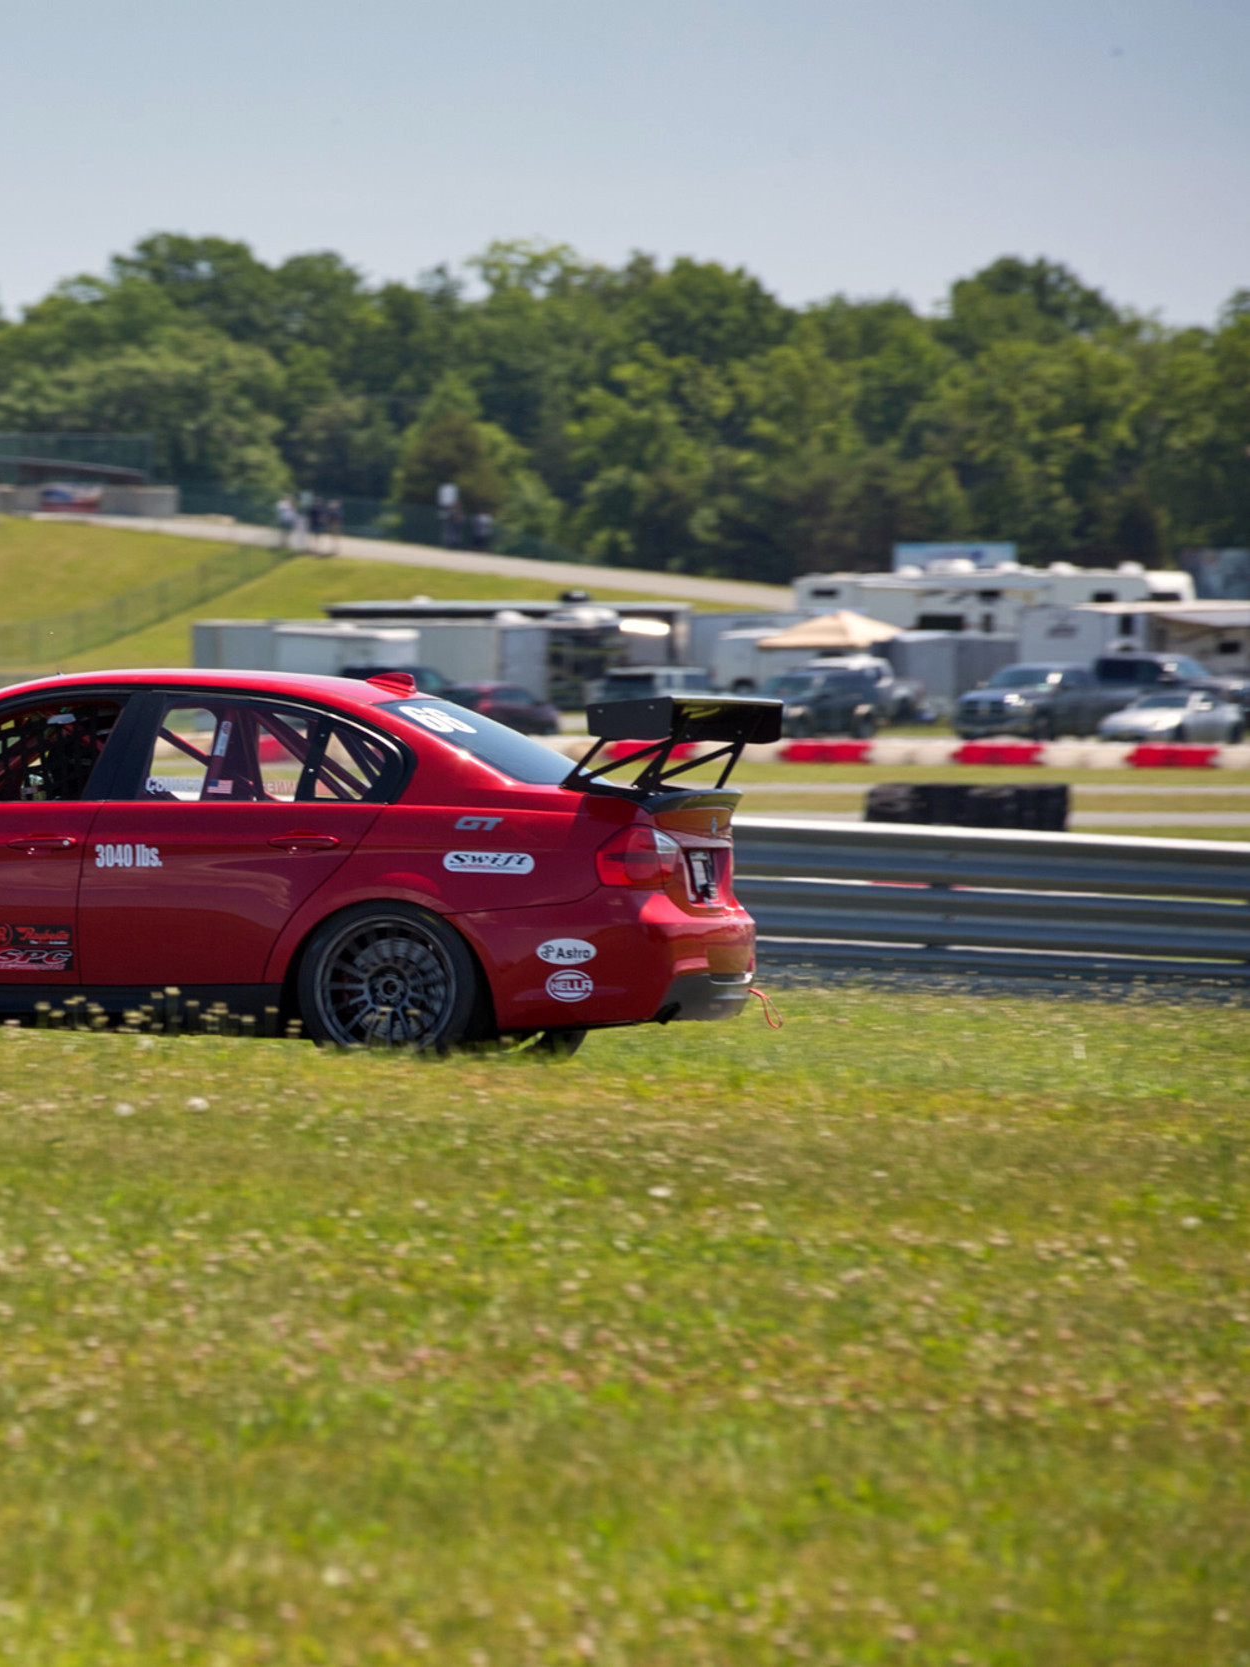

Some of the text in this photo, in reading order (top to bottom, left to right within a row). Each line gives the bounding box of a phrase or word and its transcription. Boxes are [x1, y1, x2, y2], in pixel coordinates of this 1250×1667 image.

[398, 706, 478, 734] 66
[454, 816, 504, 831] GT
[95, 844, 163, 867] 3040 lbs.
[449, 853, 528, 868] Swift
[557, 947, 591, 959] Astro
[551, 980, 593, 992] HELLA
